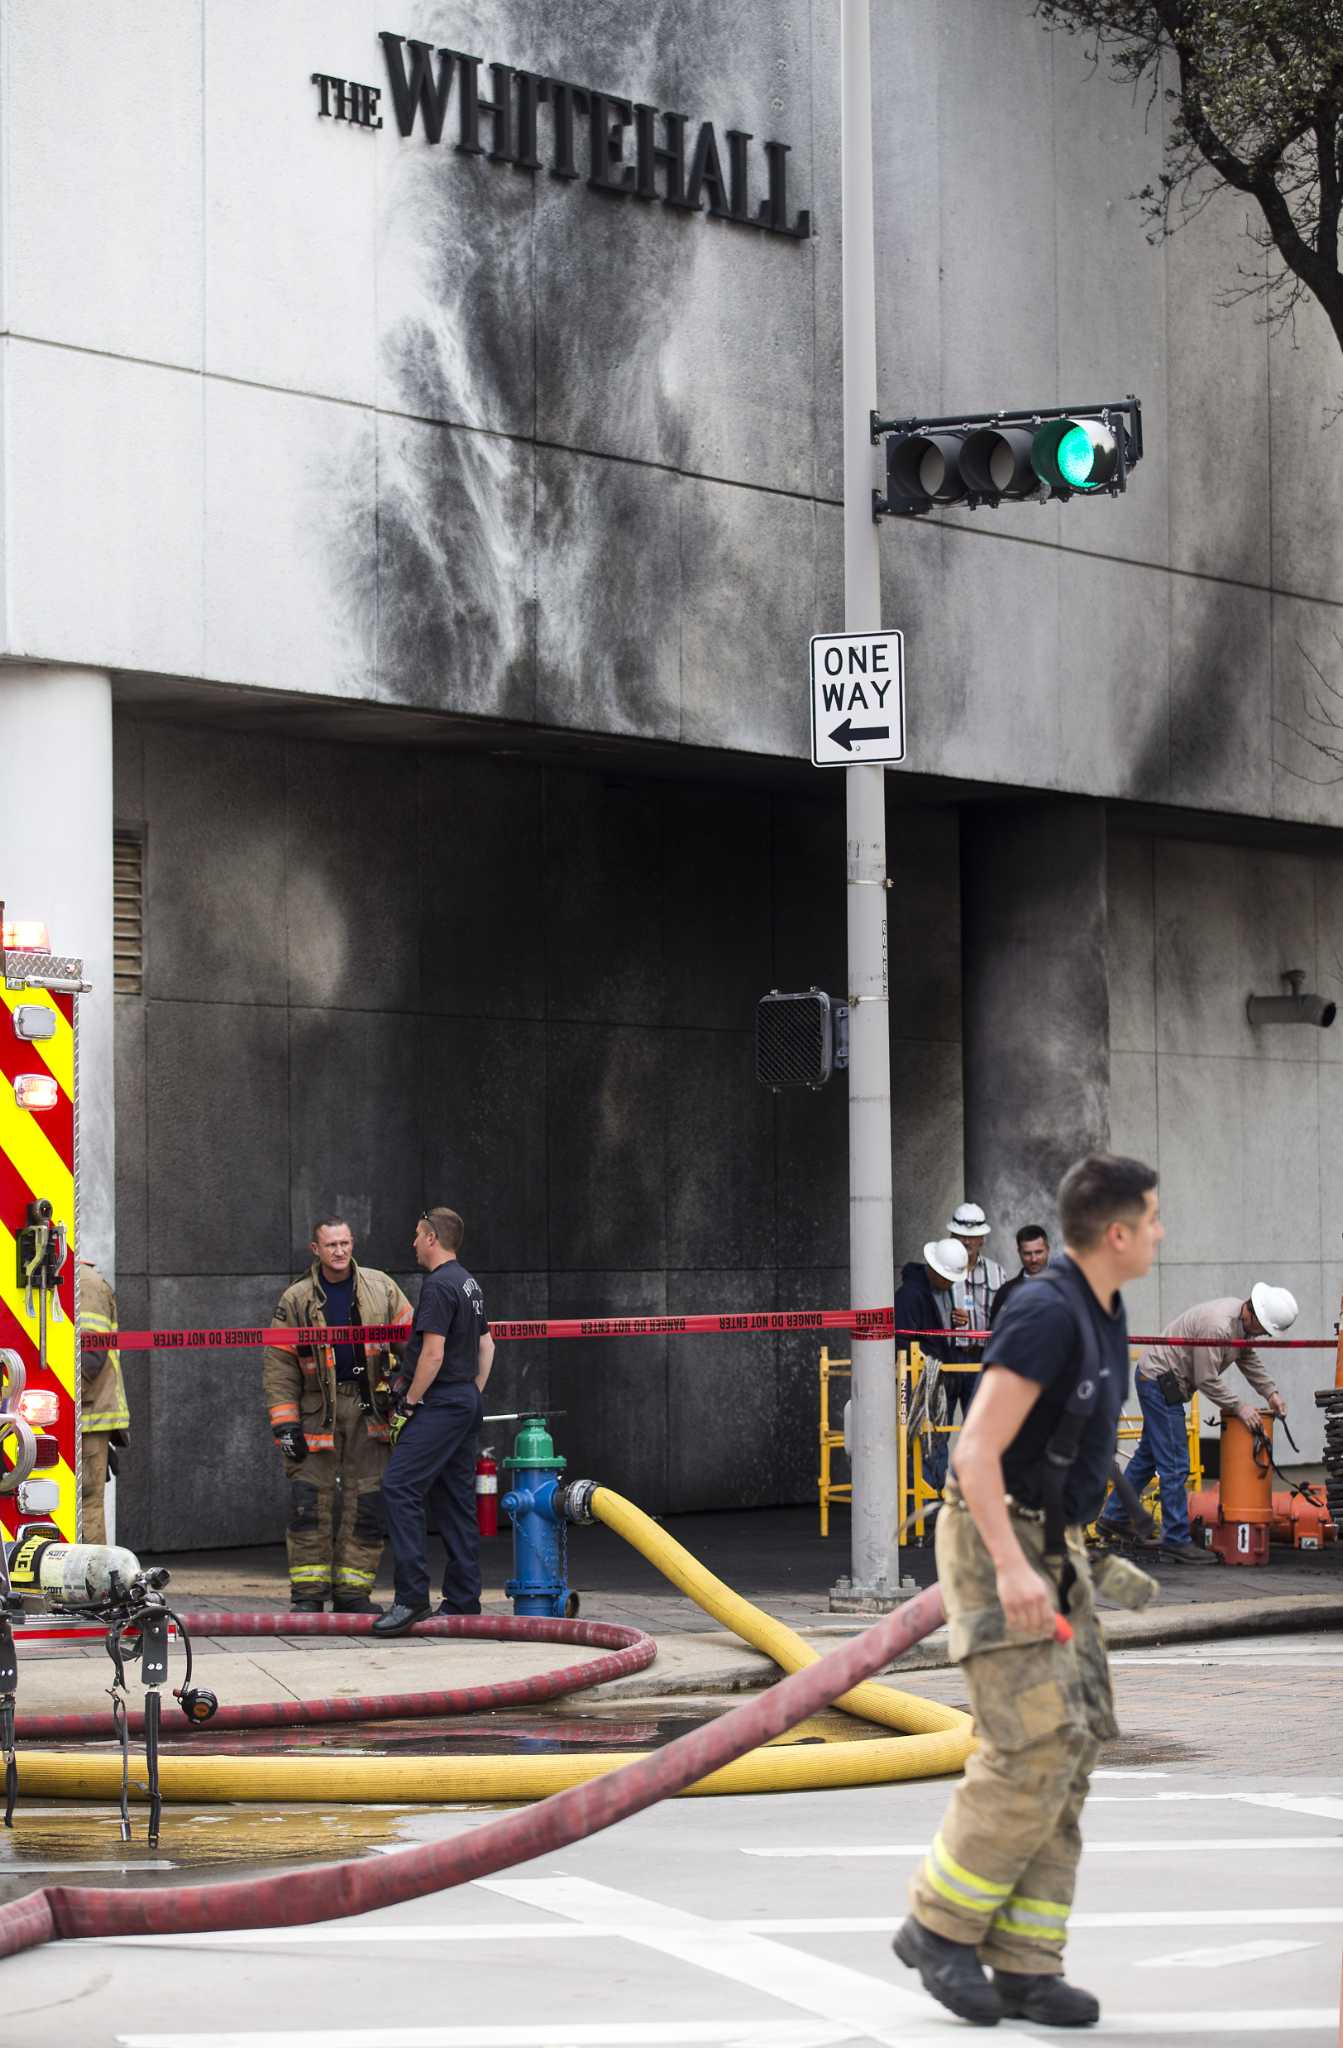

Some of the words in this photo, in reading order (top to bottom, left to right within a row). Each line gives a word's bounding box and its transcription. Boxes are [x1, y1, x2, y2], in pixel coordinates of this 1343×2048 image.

[312, 73, 383, 129] THE
[378, 31, 810, 239] WHITEHALL
[825, 644, 889, 676] ONE
[822, 680, 891, 712] WAY
[650, 1318, 686, 1331] DANGER
[720, 1316, 748, 1329] ENTER
[751, 1316, 768, 1328] NOT
[771, 1315, 784, 1327] DO
[786, 1313, 822, 1326] DANGER
[856, 1311, 883, 1326] ENTER
[495, 1324, 507, 1336] DO
[511, 1323, 547, 1336] DANGER
[581, 1321, 609, 1334] ENTER
[614, 1320, 630, 1333] NOT
[634, 1319, 647, 1332] DO
[153, 1333, 184, 1346] ENTER
[187, 1332, 206, 1345] NOT
[209, 1332, 222, 1344] DO
[225, 1331, 263, 1344] DANGER
[298, 1329, 328, 1342] ENTER
[331, 1328, 349, 1342] NOT
[353, 1328, 366, 1341] DO
[368, 1327, 405, 1340] DANGER
